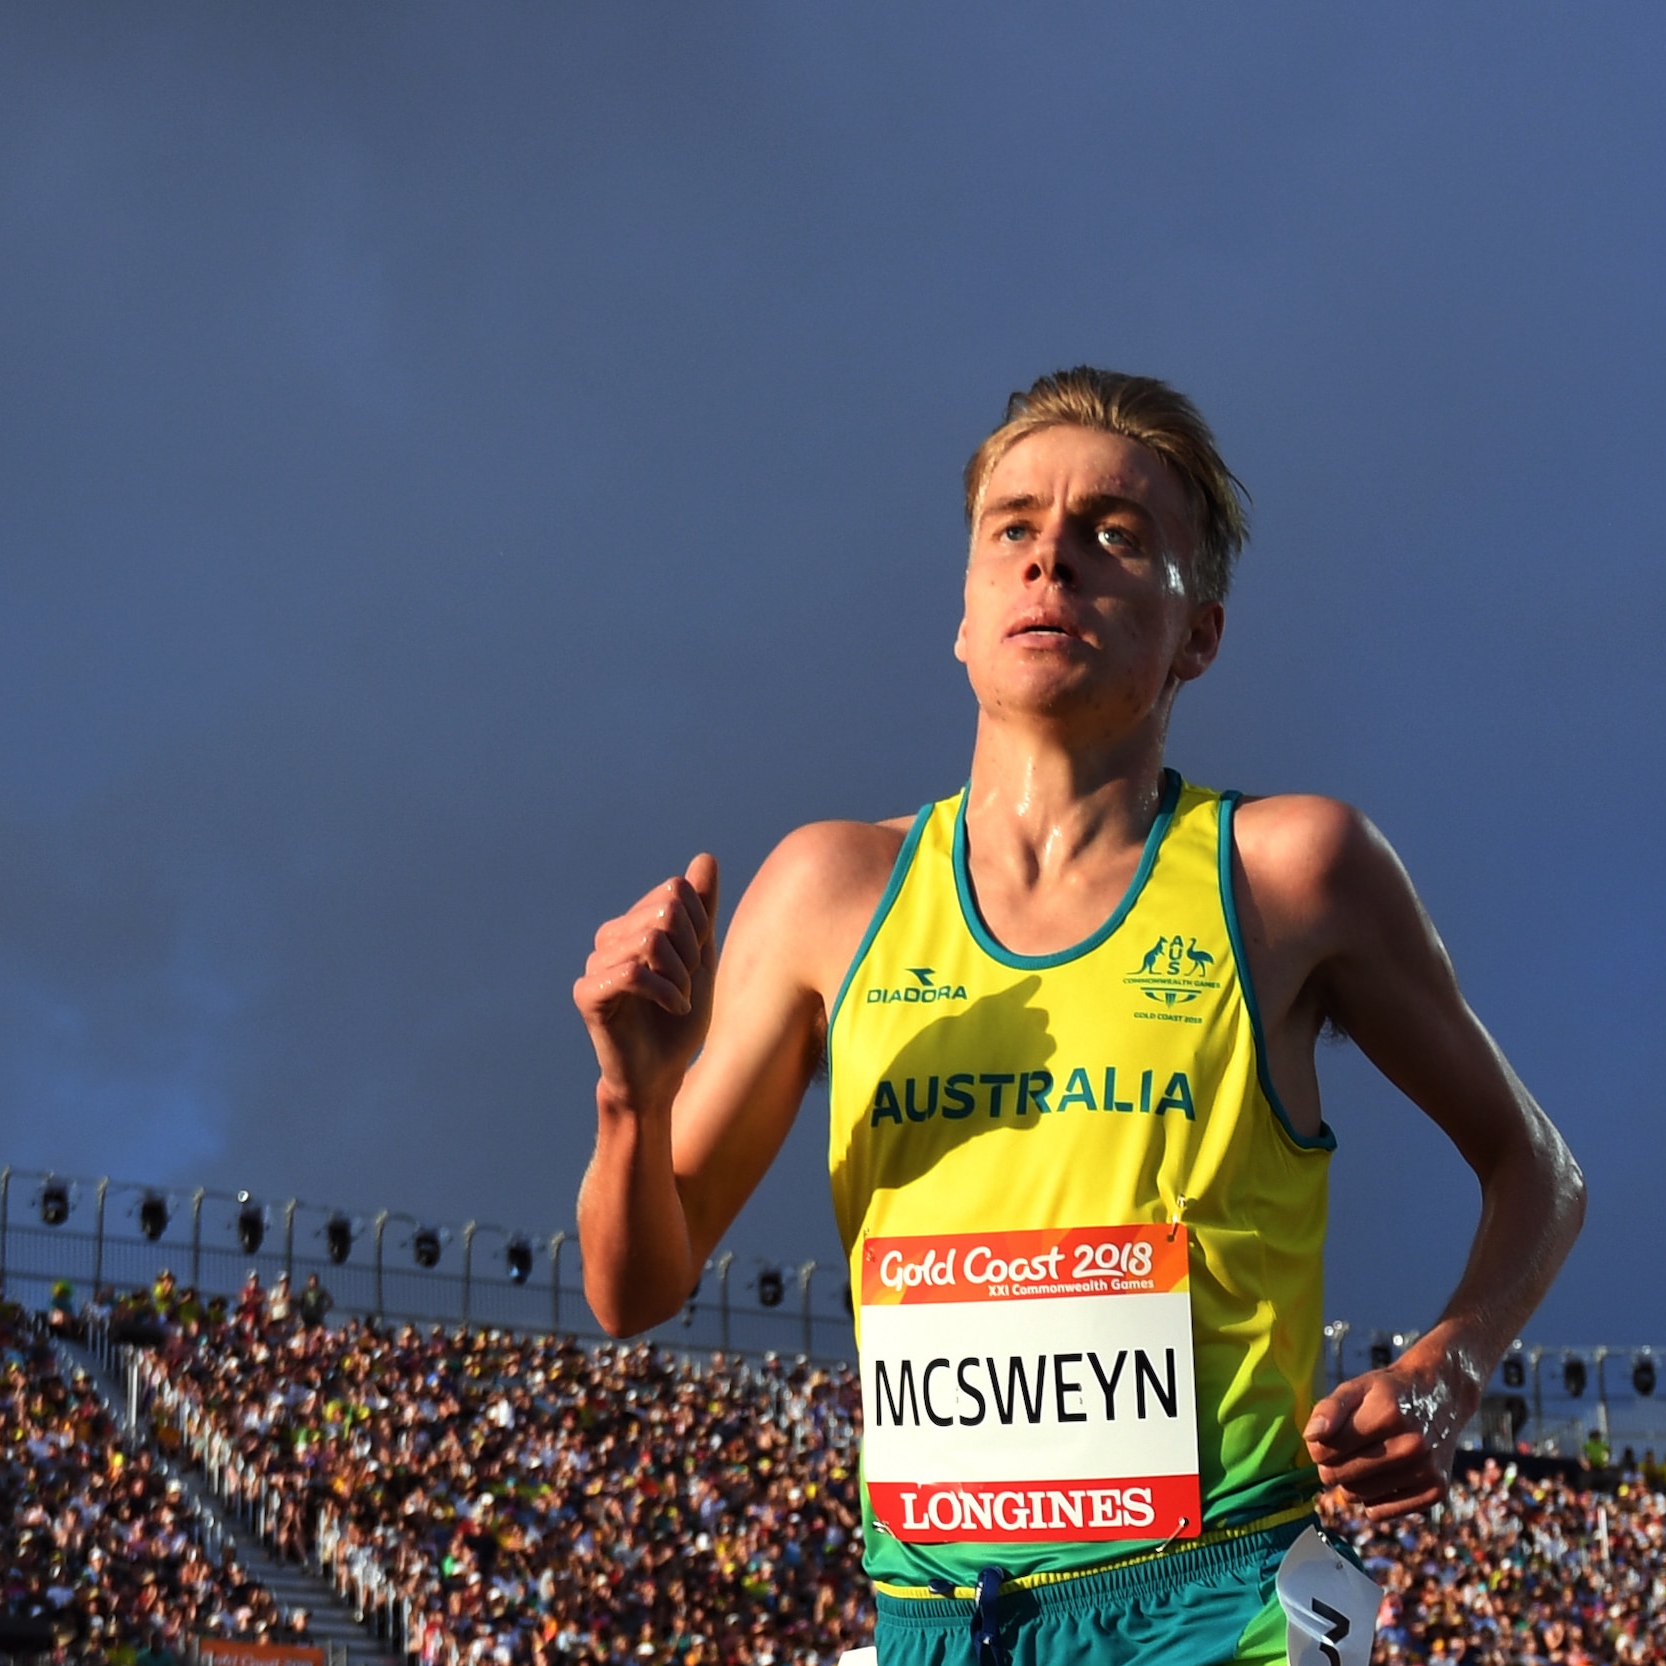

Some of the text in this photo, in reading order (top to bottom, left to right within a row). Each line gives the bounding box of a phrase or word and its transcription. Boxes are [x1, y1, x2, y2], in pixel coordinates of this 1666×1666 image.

[1167, 934, 1184, 975] AUS
[867, 985, 967, 1003] DIADORA
[870, 1066, 1196, 1127] AUSTRALIA
[880, 1242, 1153, 1292] Gold Coast 2018
[988, 1278, 1155, 1297] XXI Commonwealth Games
[875, 1348, 1178, 1427] MCSWEYN
[900, 1487, 1155, 1530] LONGINES
